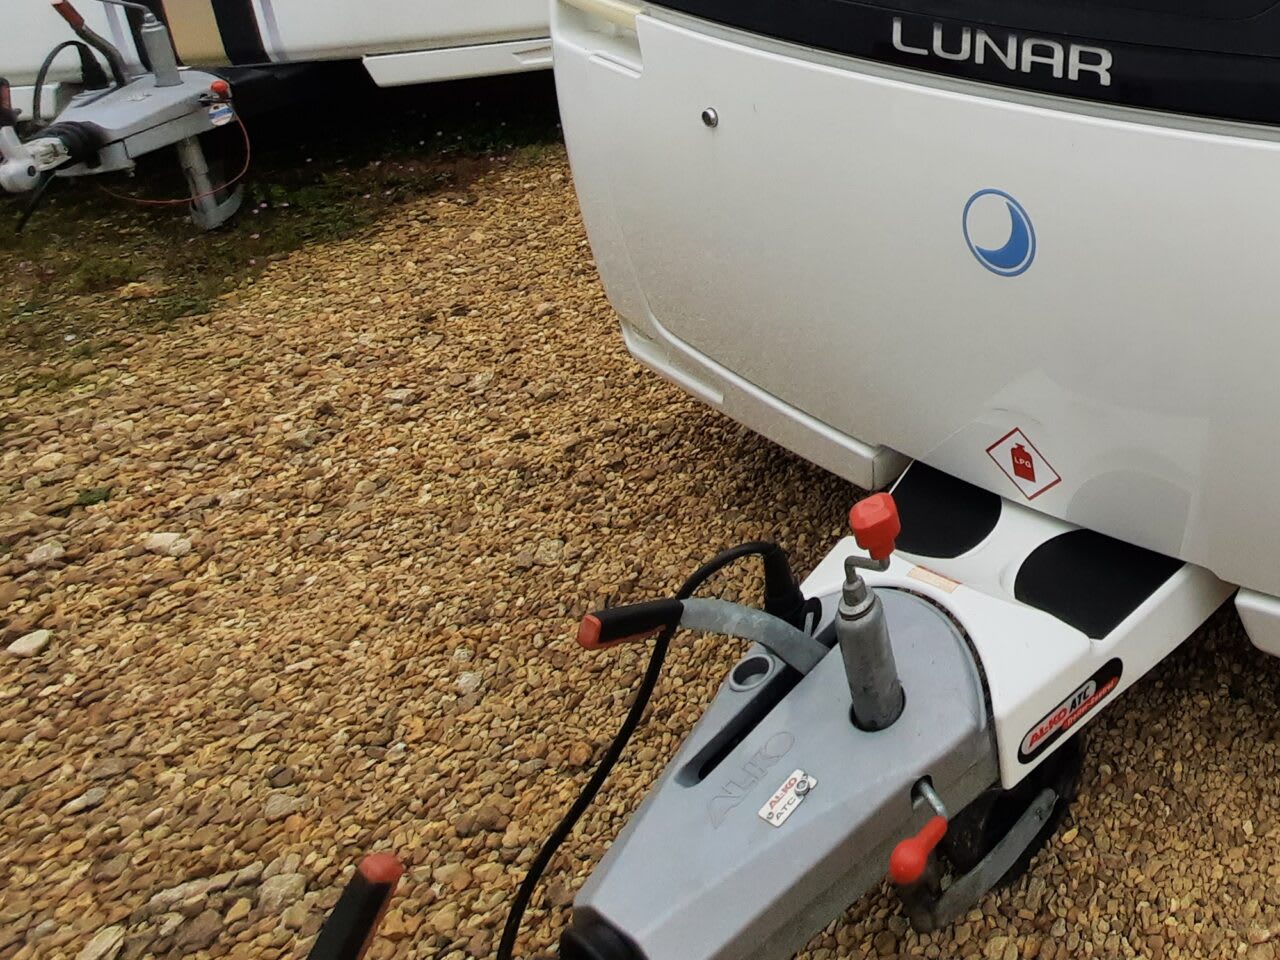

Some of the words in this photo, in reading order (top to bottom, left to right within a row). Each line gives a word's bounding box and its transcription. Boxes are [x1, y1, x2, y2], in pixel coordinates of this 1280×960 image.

[892, 16, 1113, 86] LUNAR
[1014, 456, 1032, 469] LPG
[1069, 685, 1091, 714] ATC
[776, 796, 797, 820] ATC
